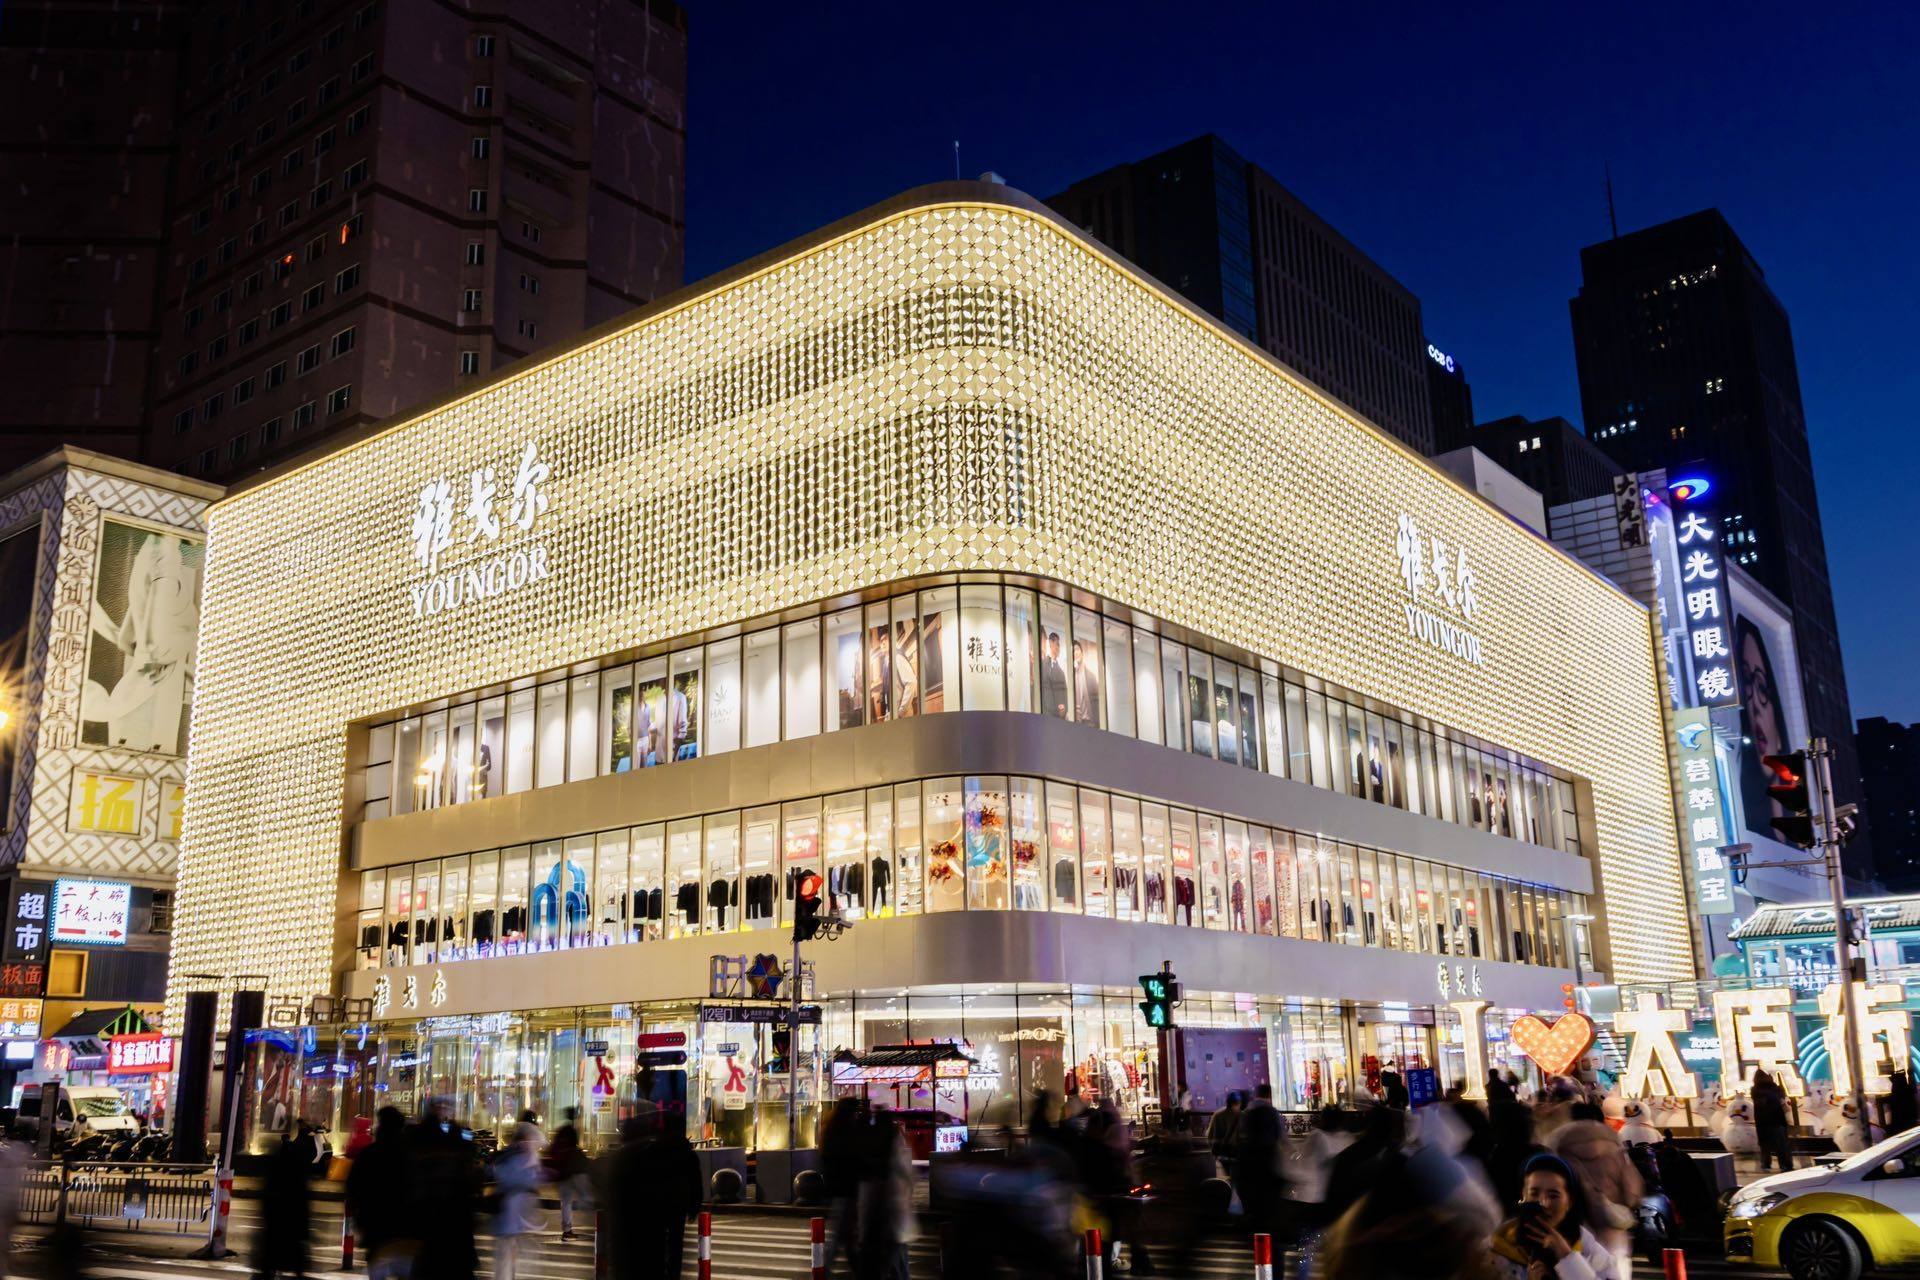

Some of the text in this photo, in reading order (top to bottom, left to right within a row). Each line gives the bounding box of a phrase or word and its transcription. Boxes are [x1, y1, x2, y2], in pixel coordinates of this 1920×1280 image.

[411, 545, 550, 619] YOUNGOR
[1678, 512, 1734, 700] 大光明眼镜
[1403, 603, 1483, 665] YOUNGOR
[15, 893, 45, 951] 超市
[2, 964, 42, 986] 板面
[1, 1002, 39, 1020] 超市
[1450, 1001, 1494, 1100] I
